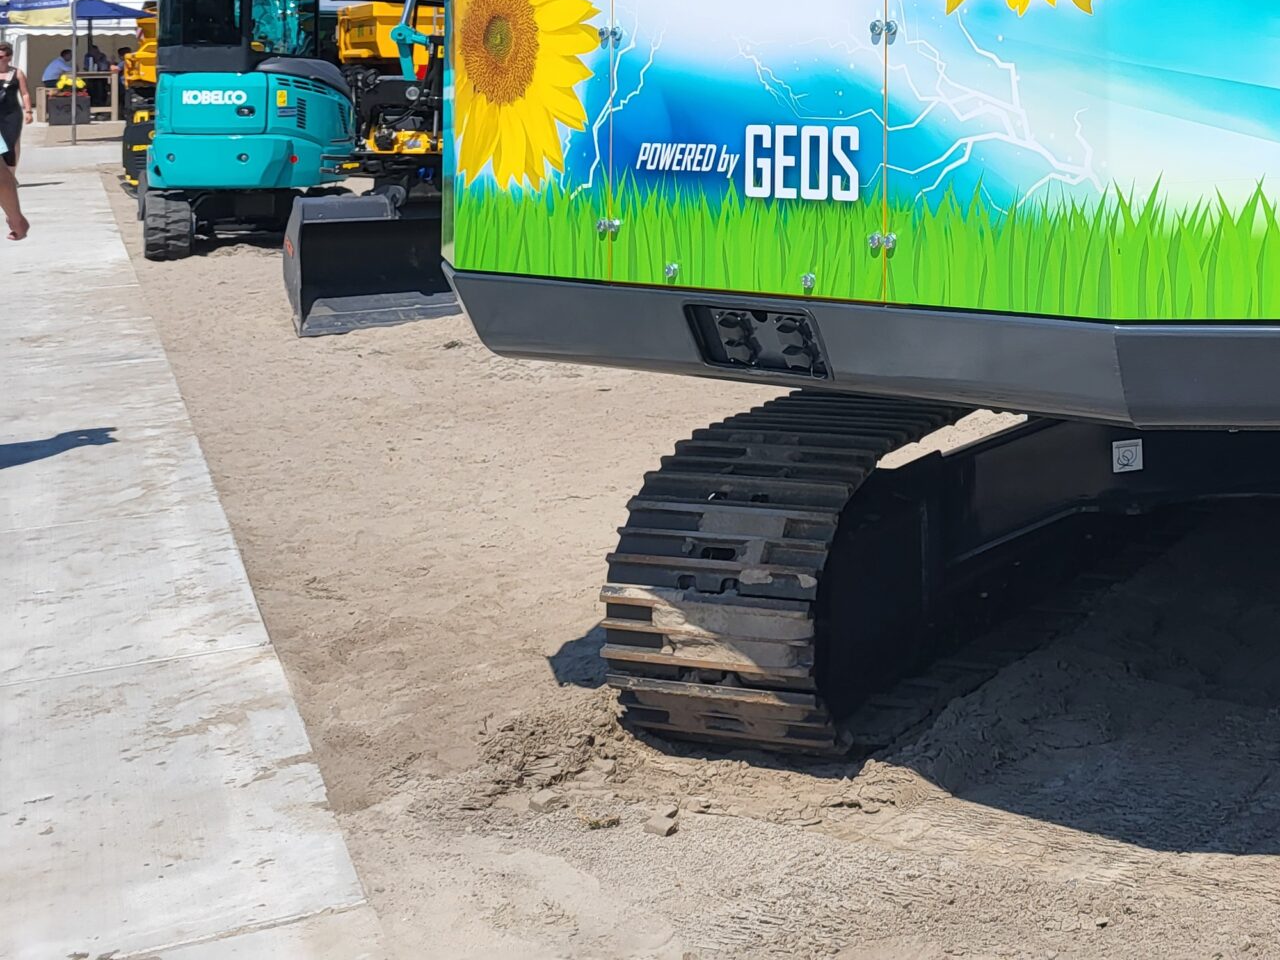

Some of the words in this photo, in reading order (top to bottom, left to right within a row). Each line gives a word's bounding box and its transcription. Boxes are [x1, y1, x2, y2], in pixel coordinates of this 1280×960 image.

[182, 90, 247, 105] KOBELCO
[636, 142, 717, 173] POWERED
[717, 144, 740, 178] by
[744, 124, 860, 202] GEOS
